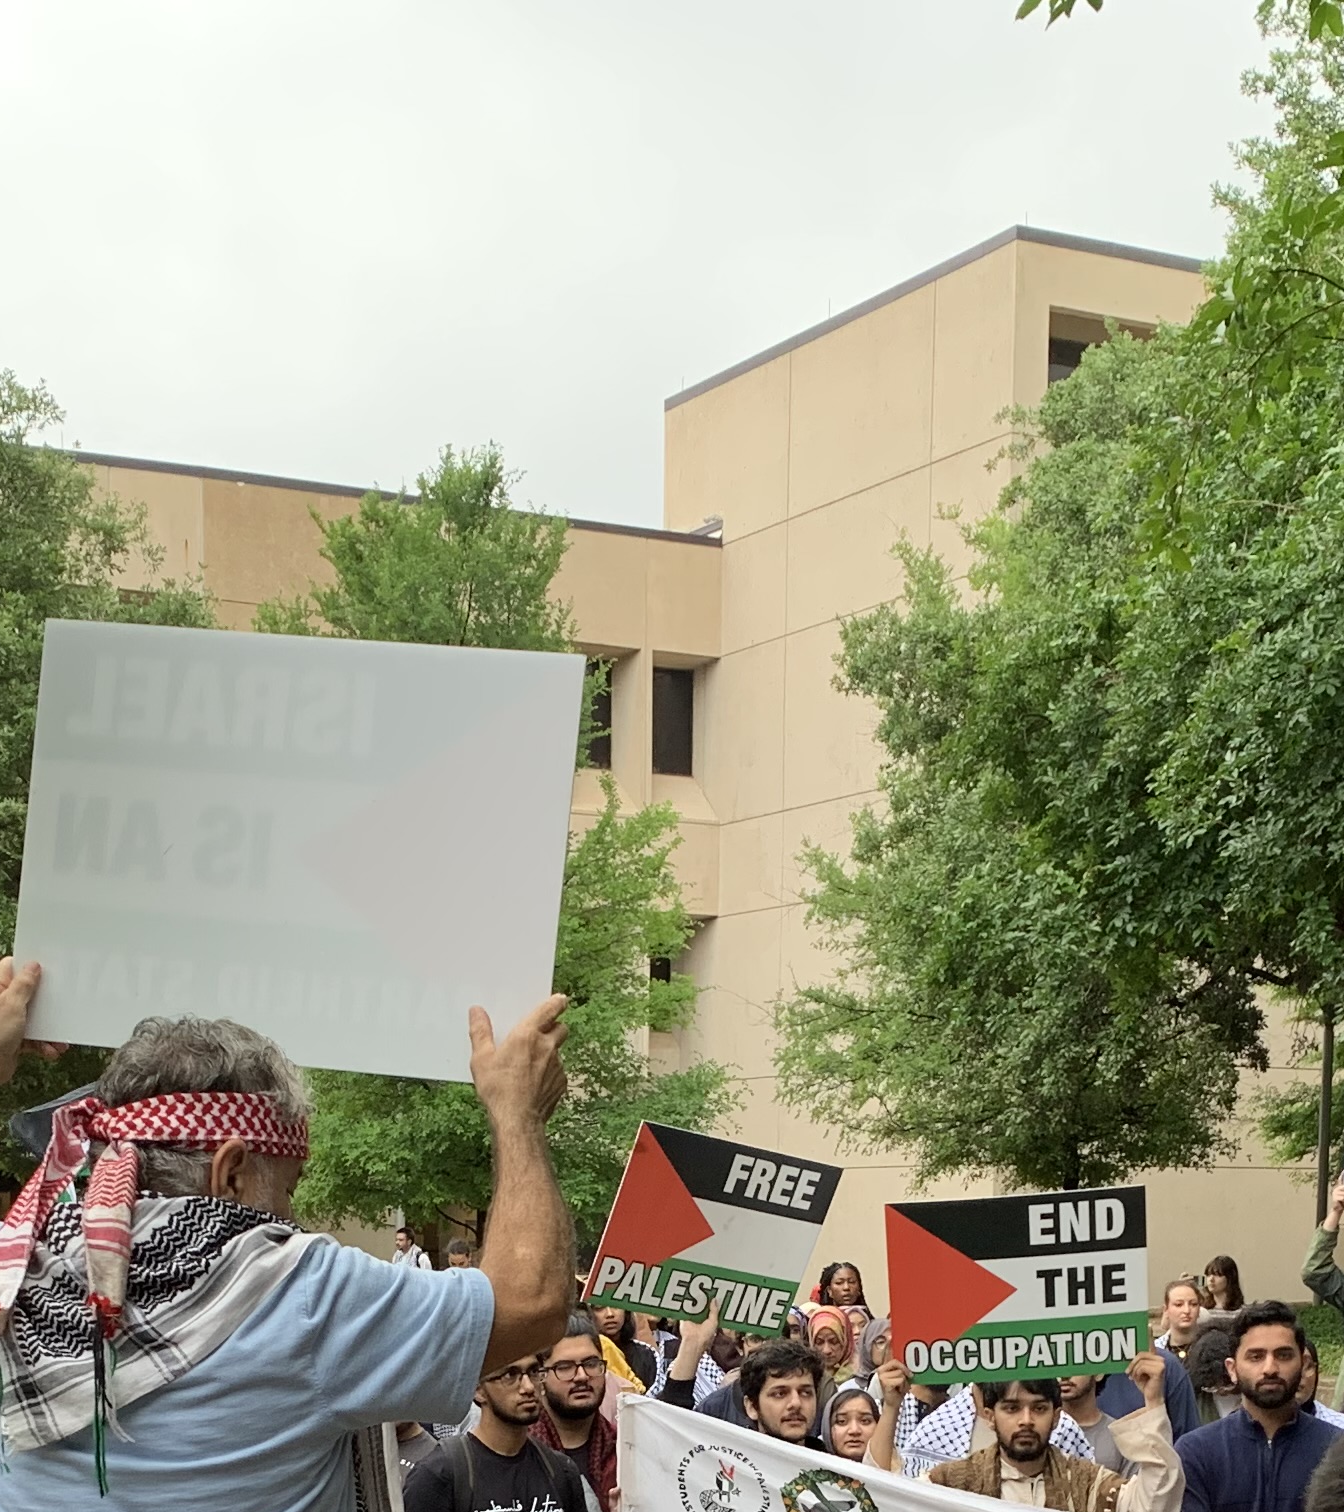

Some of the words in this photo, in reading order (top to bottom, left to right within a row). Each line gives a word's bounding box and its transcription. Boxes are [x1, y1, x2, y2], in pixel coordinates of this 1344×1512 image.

[722, 1153, 822, 1211] FREE
[1028, 1198, 1126, 1246] END
[592, 1256, 791, 1330] PALESTINE
[1036, 1263, 1127, 1308] THE
[904, 1326, 1138, 1374] OCCUPATION
